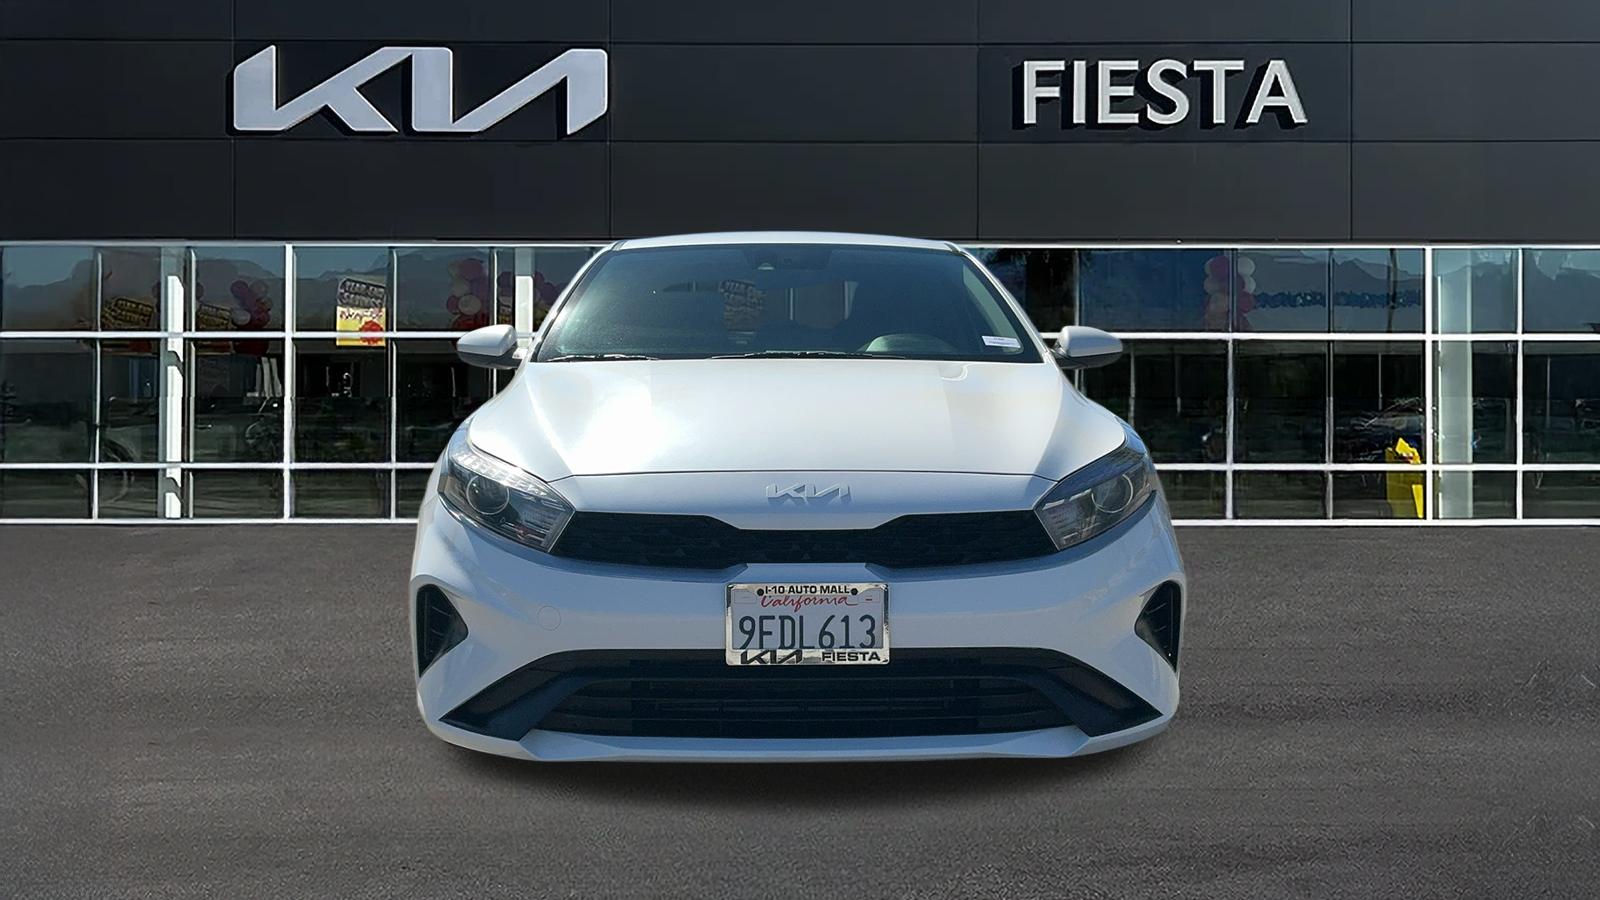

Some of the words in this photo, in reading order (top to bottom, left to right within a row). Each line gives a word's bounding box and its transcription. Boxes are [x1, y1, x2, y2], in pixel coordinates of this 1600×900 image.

[233, 44, 609, 136] KIA
[1022, 58, 1309, 125] FIESTA
[765, 482, 851, 503] KIA
[765, 585, 786, 594] I-10
[788, 585, 817, 594] AUTO
[820, 585, 850, 594] MALL
[761, 595, 859, 613] California
[739, 614, 876, 650] 9FDL613
[740, 650, 803, 665] KIA
[821, 651, 881, 662] FIESTA
